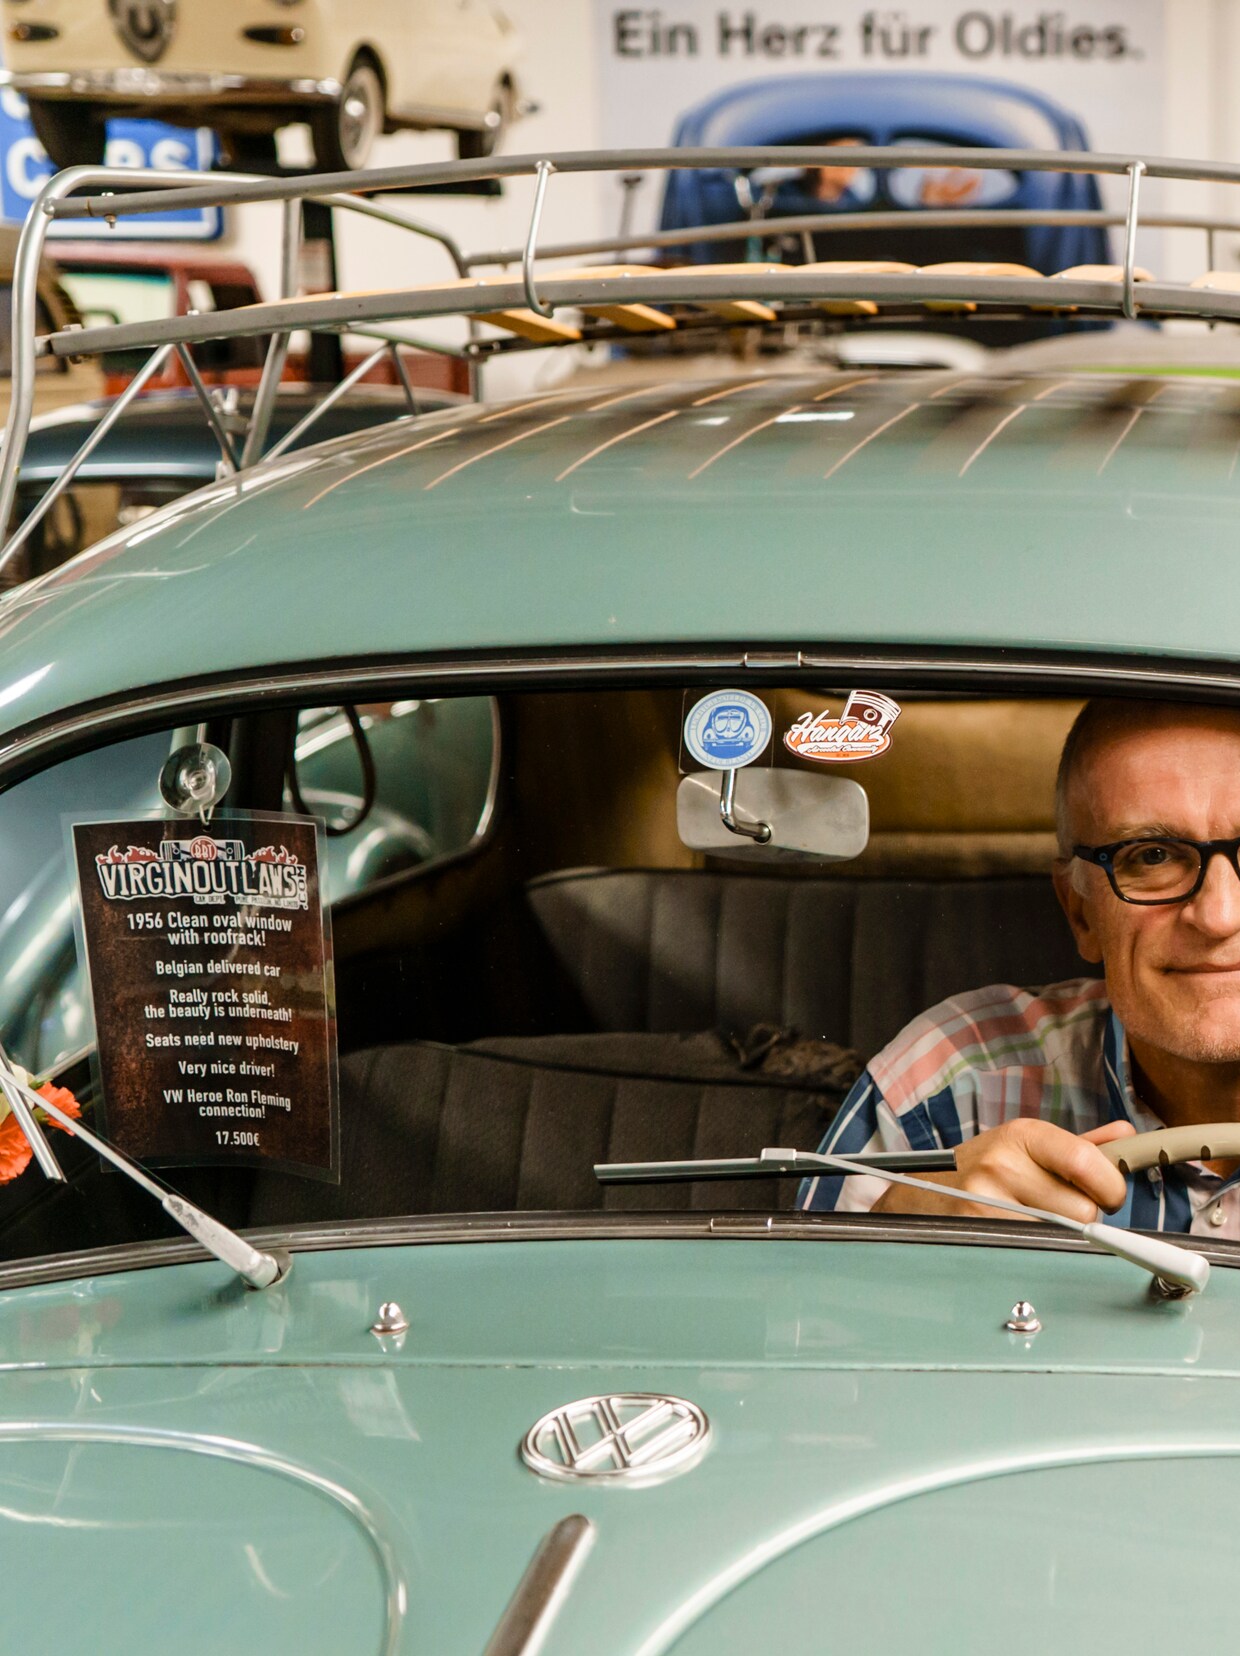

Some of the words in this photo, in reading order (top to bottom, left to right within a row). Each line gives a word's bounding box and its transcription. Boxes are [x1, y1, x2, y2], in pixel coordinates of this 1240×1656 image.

[614, 9, 697, 57] Ein
[717, 9, 840, 57] Herz
[861, 9, 933, 57] für
[955, 9, 1146, 59] Oldies.
[101, 860, 297, 898] VIRGINOUTLAWS
[126, 912, 163, 930] 1956
[167, 911, 209, 929] Clean
[212, 910, 244, 929] oval
[244, 910, 293, 934] window
[167, 928, 200, 946] with
[203, 927, 268, 949] roofrack!
[155, 959, 204, 978] Belgian
[206, 959, 262, 976] delivered
[263, 964, 281, 978] car
[168, 988, 208, 1007] Really
[211, 988, 240, 1005] rock
[144, 1004, 166, 1019] the
[168, 1003, 211, 1021] beauty
[213, 1003, 226, 1017] is
[228, 1003, 292, 1023] underneath!
[145, 1033, 182, 1048] Seats
[184, 1031, 215, 1046] need
[217, 1034, 243, 1046] new
[245, 1033, 299, 1056] upholstery
[177, 1060, 207, 1078] Very
[210, 1060, 236, 1075] nice
[239, 1060, 275, 1078] driver!
[162, 1089, 183, 1104] VW
[186, 1088, 223, 1103] Heroe
[226, 1088, 249, 1103] Ron
[249, 1089, 292, 1113] Fleming
[198, 1103, 267, 1119] connection!
[215, 1130, 260, 1147] 17.500€
